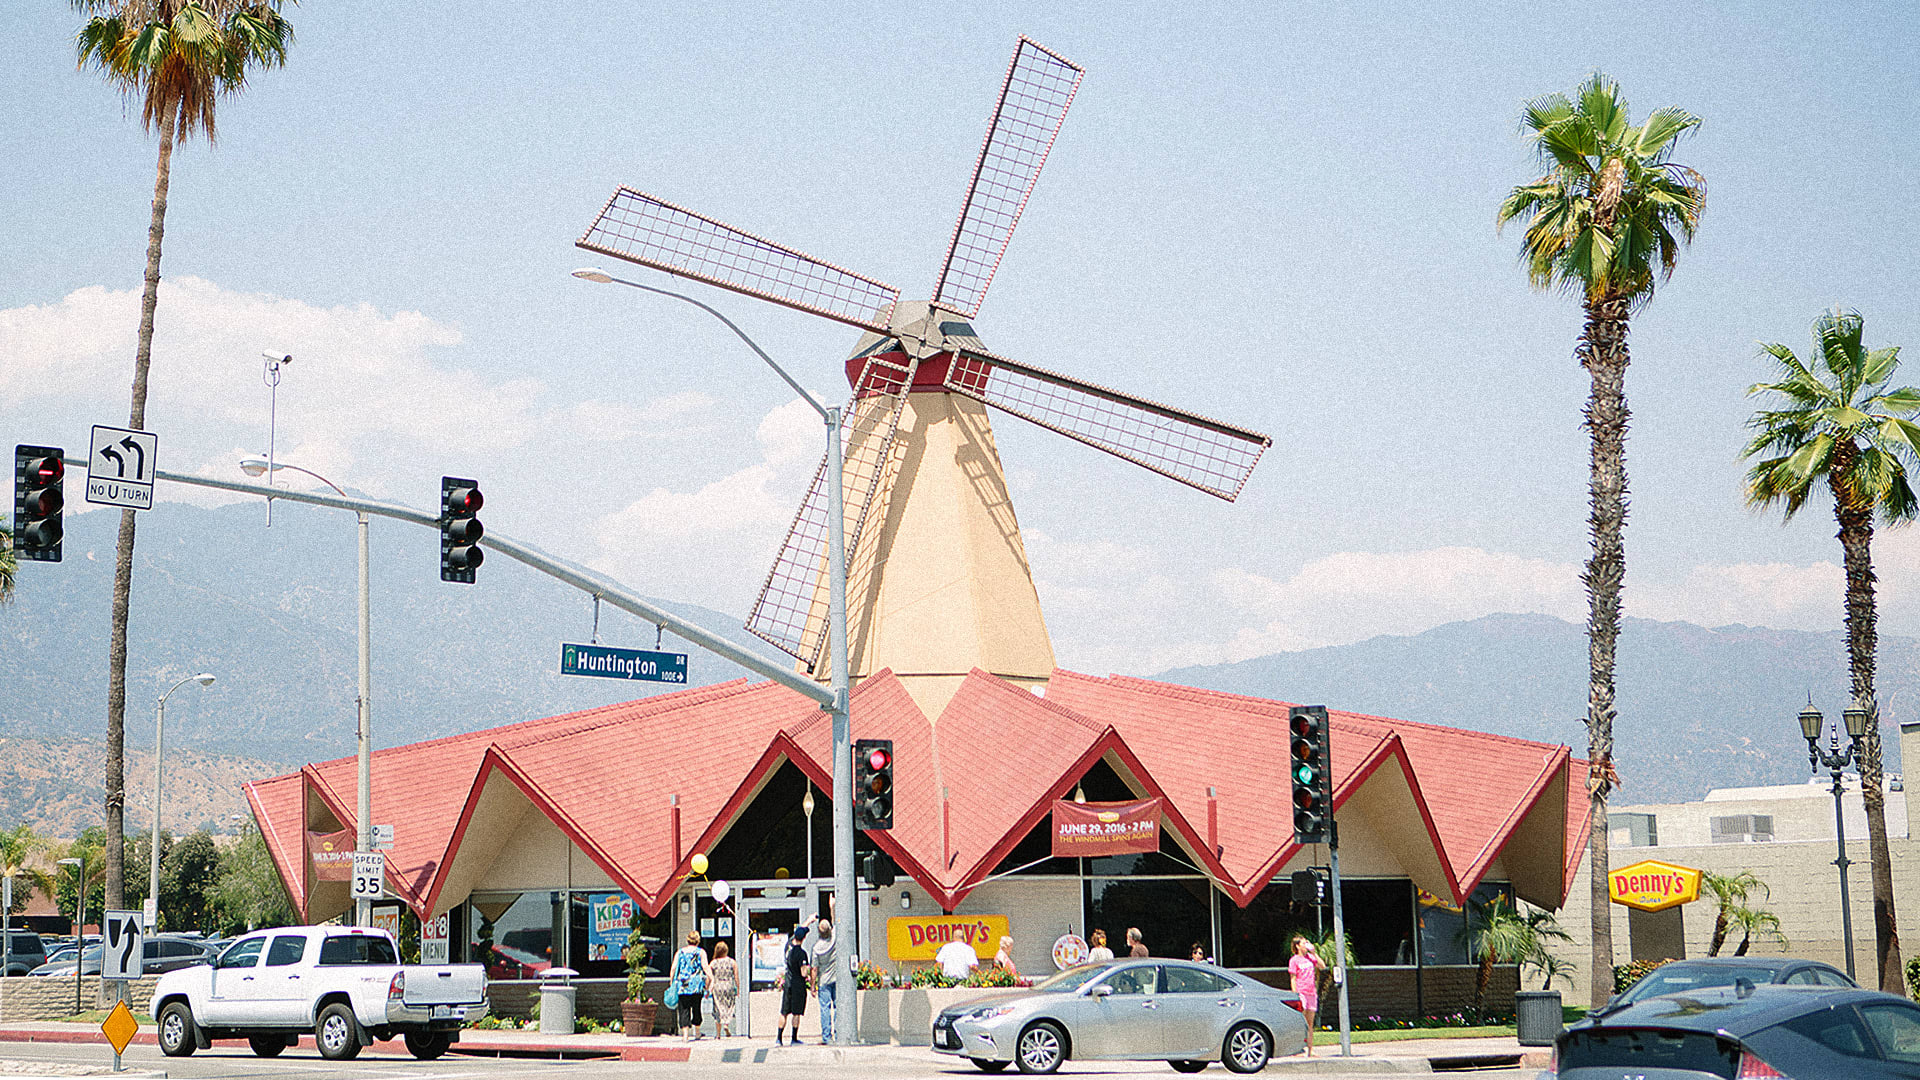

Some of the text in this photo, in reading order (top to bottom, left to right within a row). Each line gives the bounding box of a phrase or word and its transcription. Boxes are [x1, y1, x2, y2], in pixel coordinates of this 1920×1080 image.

[90, 484, 149, 501] NO U TURN
[577, 651, 657, 679] Huntington
[676, 655, 685, 665] DR
[661, 671, 677, 681] 100E
[1059, 820, 1154, 835] JUNE 29, 2016 2 PM
[1059, 835, 1073, 844] THE
[1075, 835, 1110, 843] WINDMILL
[1131, 832, 1153, 840] AGAIN
[355, 856, 382, 865] SPEED
[357, 866, 380, 874] LIMIT
[355, 877, 380, 894] 35
[1614, 871, 1685, 896] Denny's
[597, 902, 632, 922] KIDS
[597, 920, 611, 930] EAT
[721, 920, 729, 930] A
[423, 942, 446, 959] MENU
